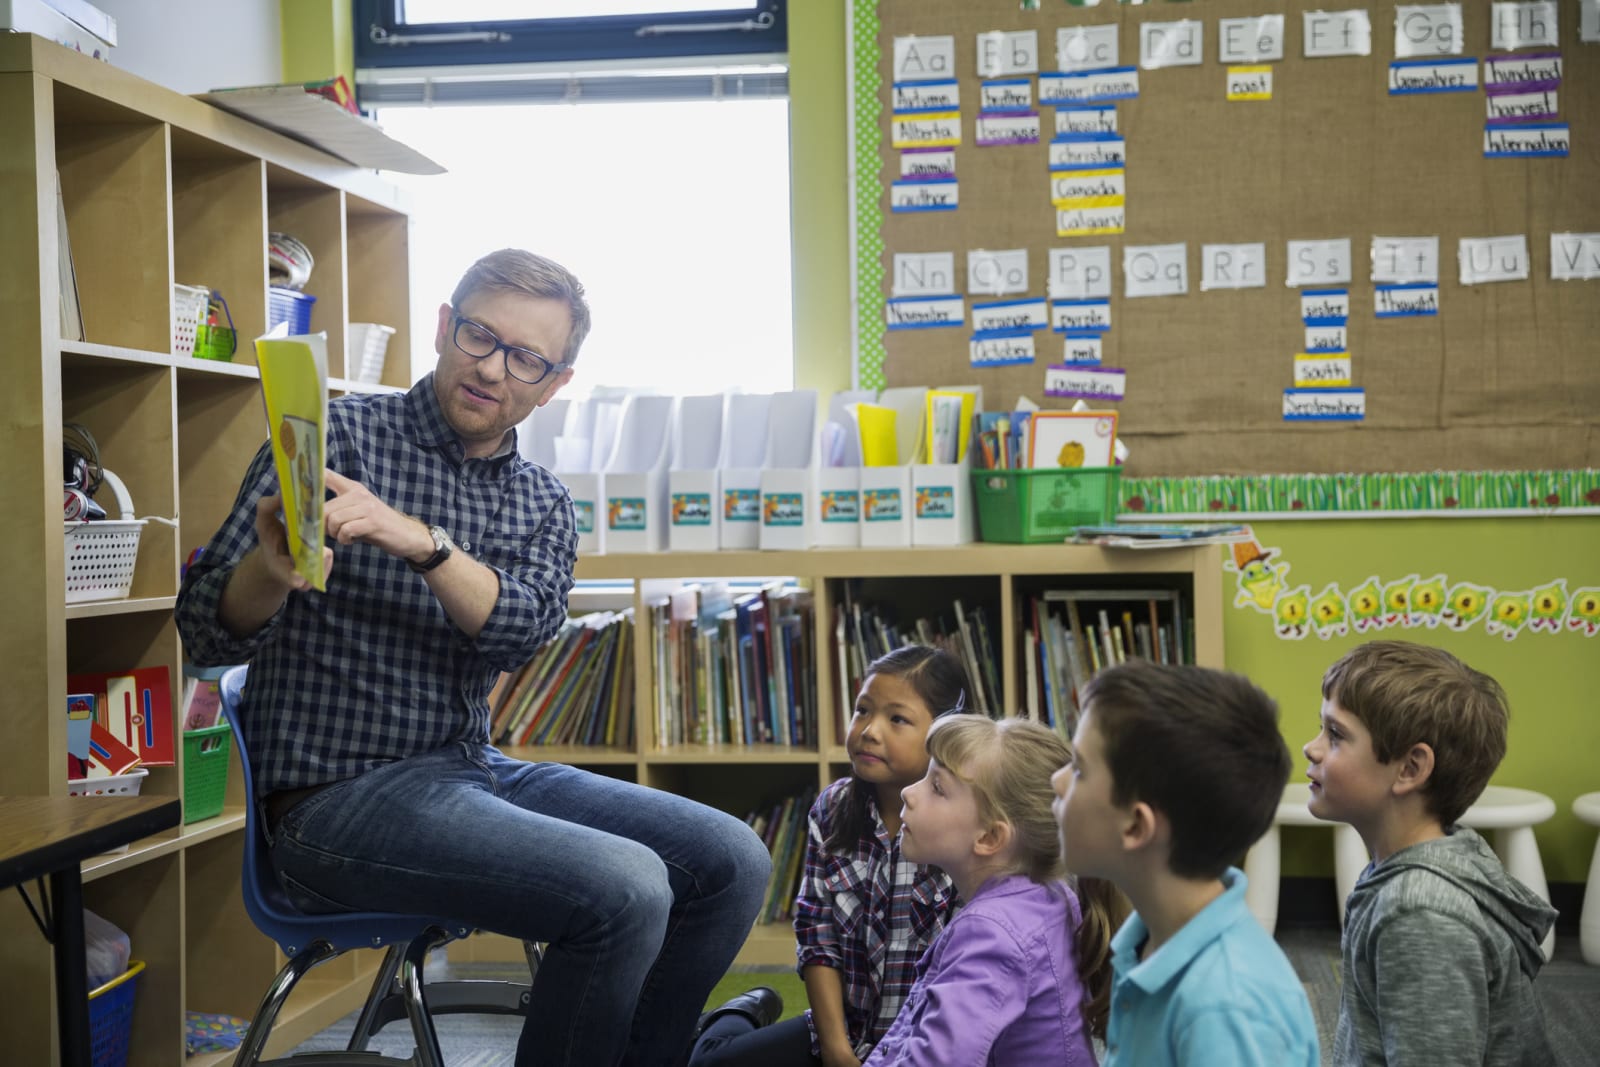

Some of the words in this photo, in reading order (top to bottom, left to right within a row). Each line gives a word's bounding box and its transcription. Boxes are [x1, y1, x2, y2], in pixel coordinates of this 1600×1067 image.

[1491, 62, 1561, 83] hundred
[1490, 93, 1551, 117] harvest
[900, 122, 953, 139] Alberta
[981, 119, 1039, 139] because
[1057, 177, 1116, 197] Canada
[1061, 210, 1124, 229] Calgary
